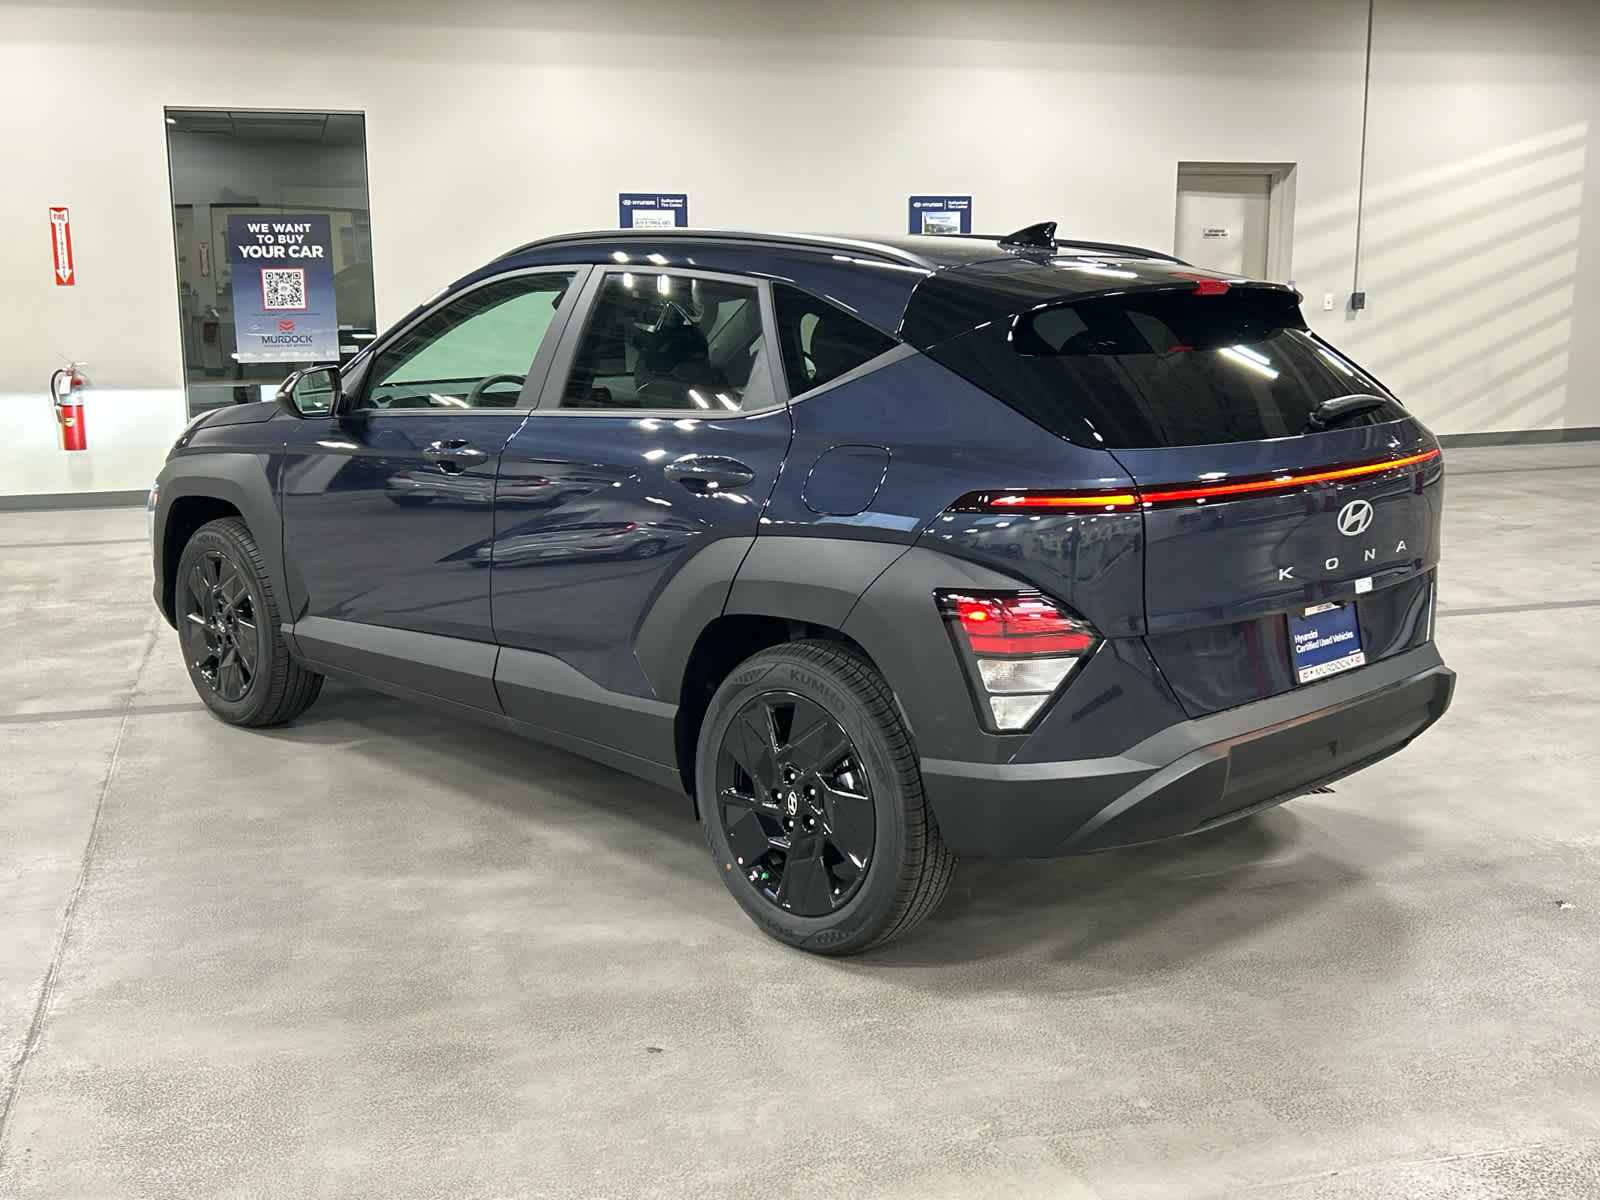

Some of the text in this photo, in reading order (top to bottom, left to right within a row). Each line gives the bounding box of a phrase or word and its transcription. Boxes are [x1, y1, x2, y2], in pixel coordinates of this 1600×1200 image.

[247, 223, 312, 233] WE WANT
[256, 234, 304, 244] TO BUY
[238, 245, 324, 258] YOUR CAR
[261, 335, 313, 344] MURDOCK
[1278, 540, 1407, 581] KONA
[1294, 629, 1318, 644] Hyundai
